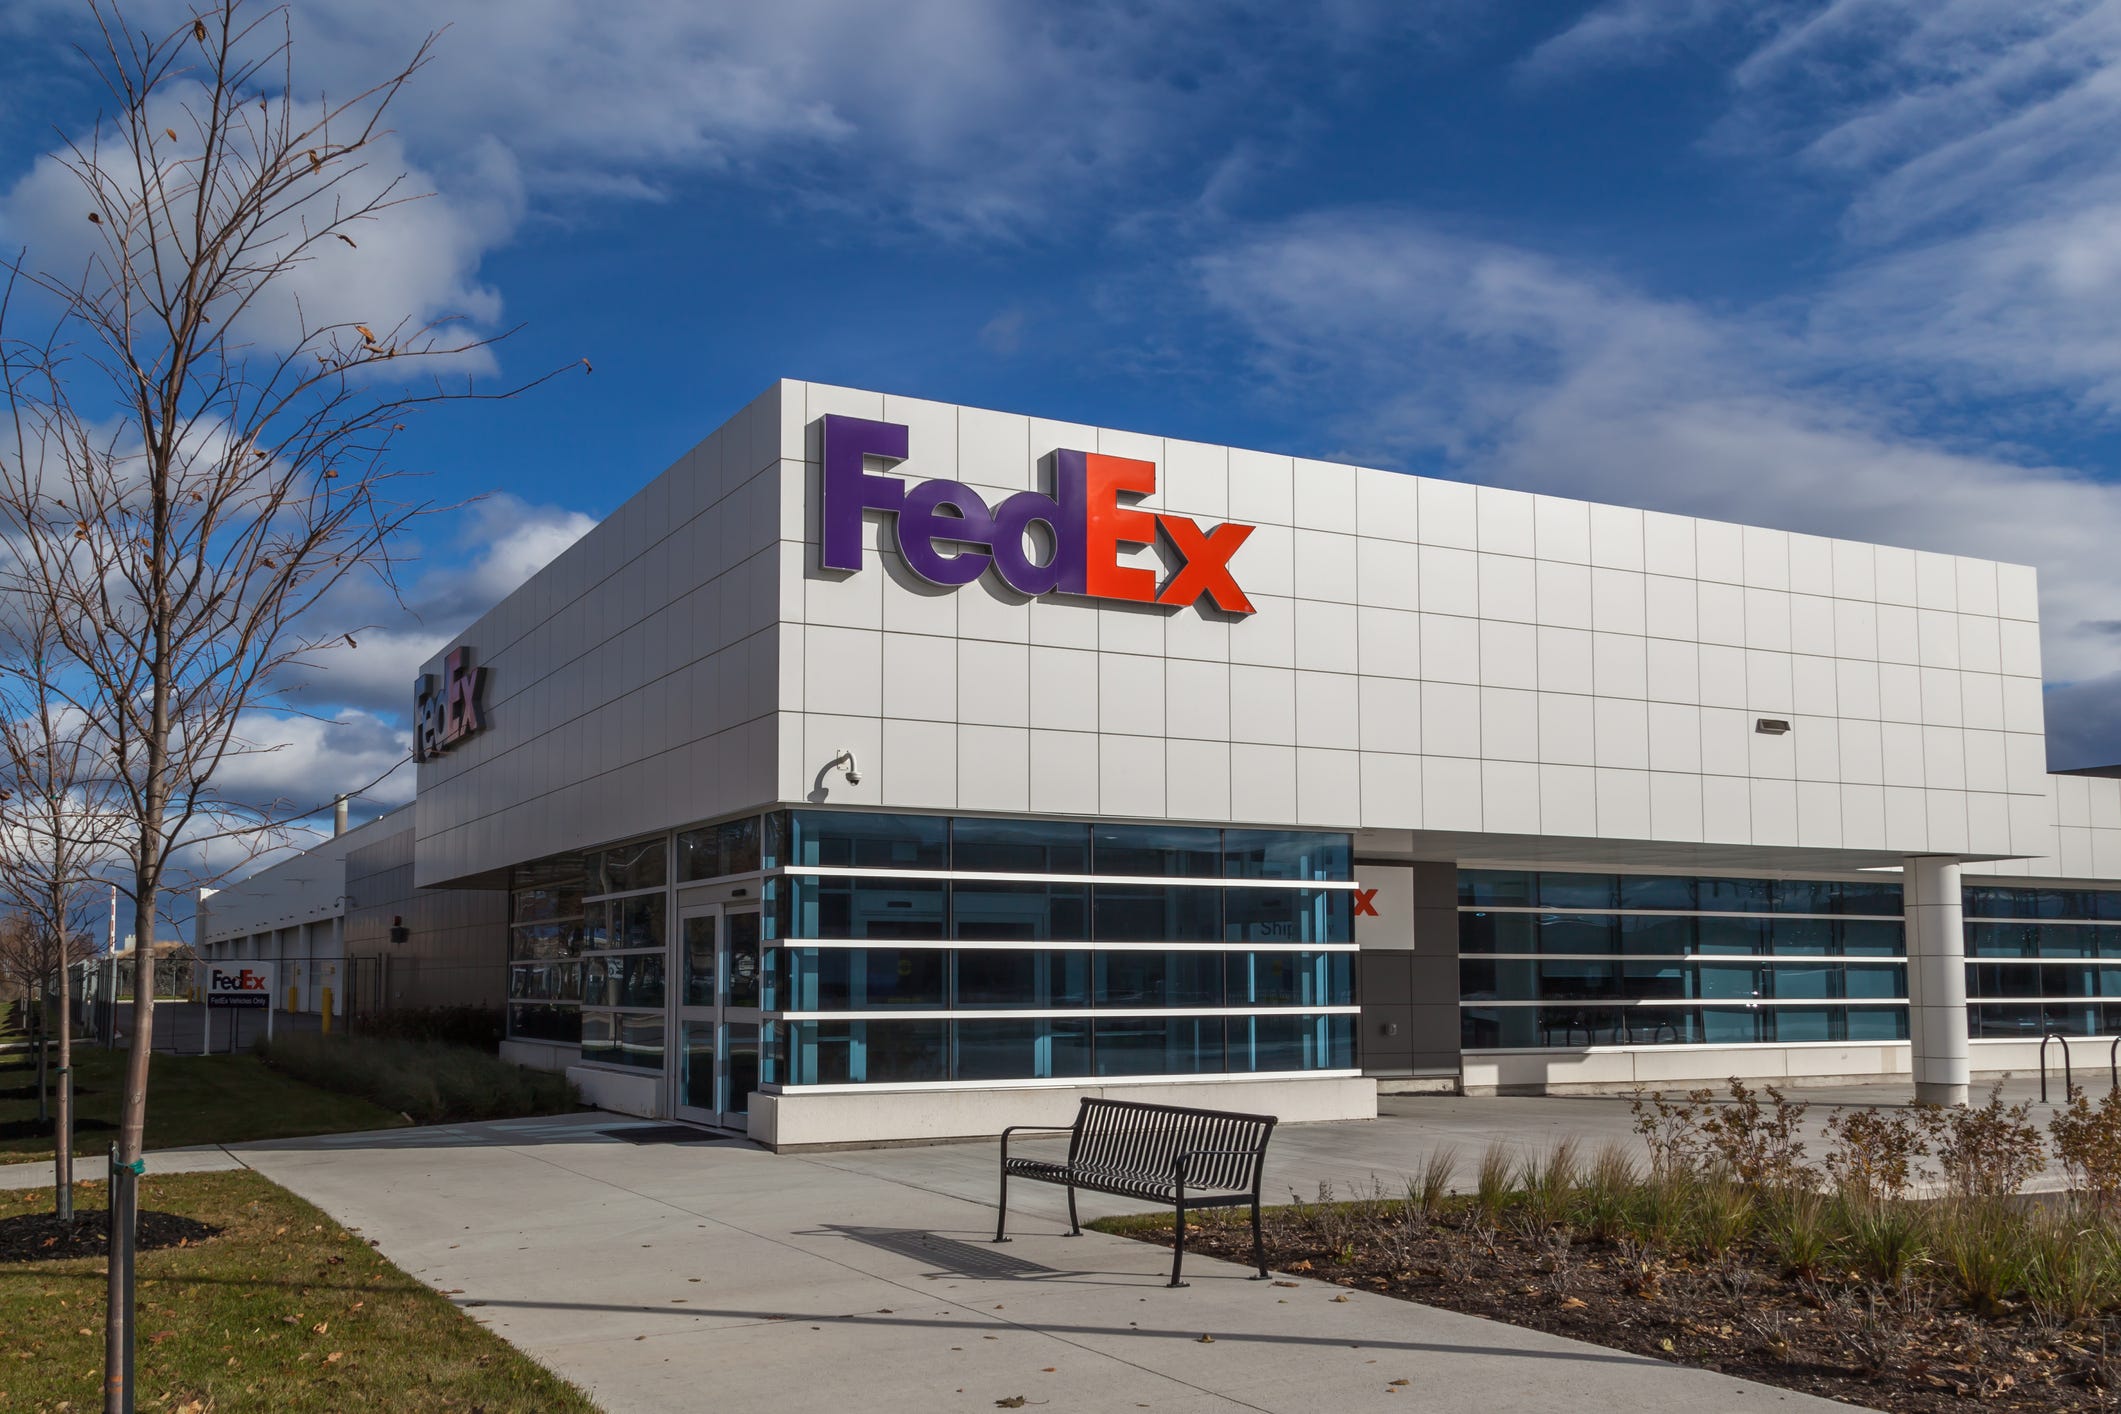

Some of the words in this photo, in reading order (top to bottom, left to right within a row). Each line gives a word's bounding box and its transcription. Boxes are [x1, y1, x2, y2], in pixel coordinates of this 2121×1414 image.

[824, 414, 1257, 614] FedEx
[413, 646, 481, 763] FedEx
[212, 969, 266, 991] FedEx
